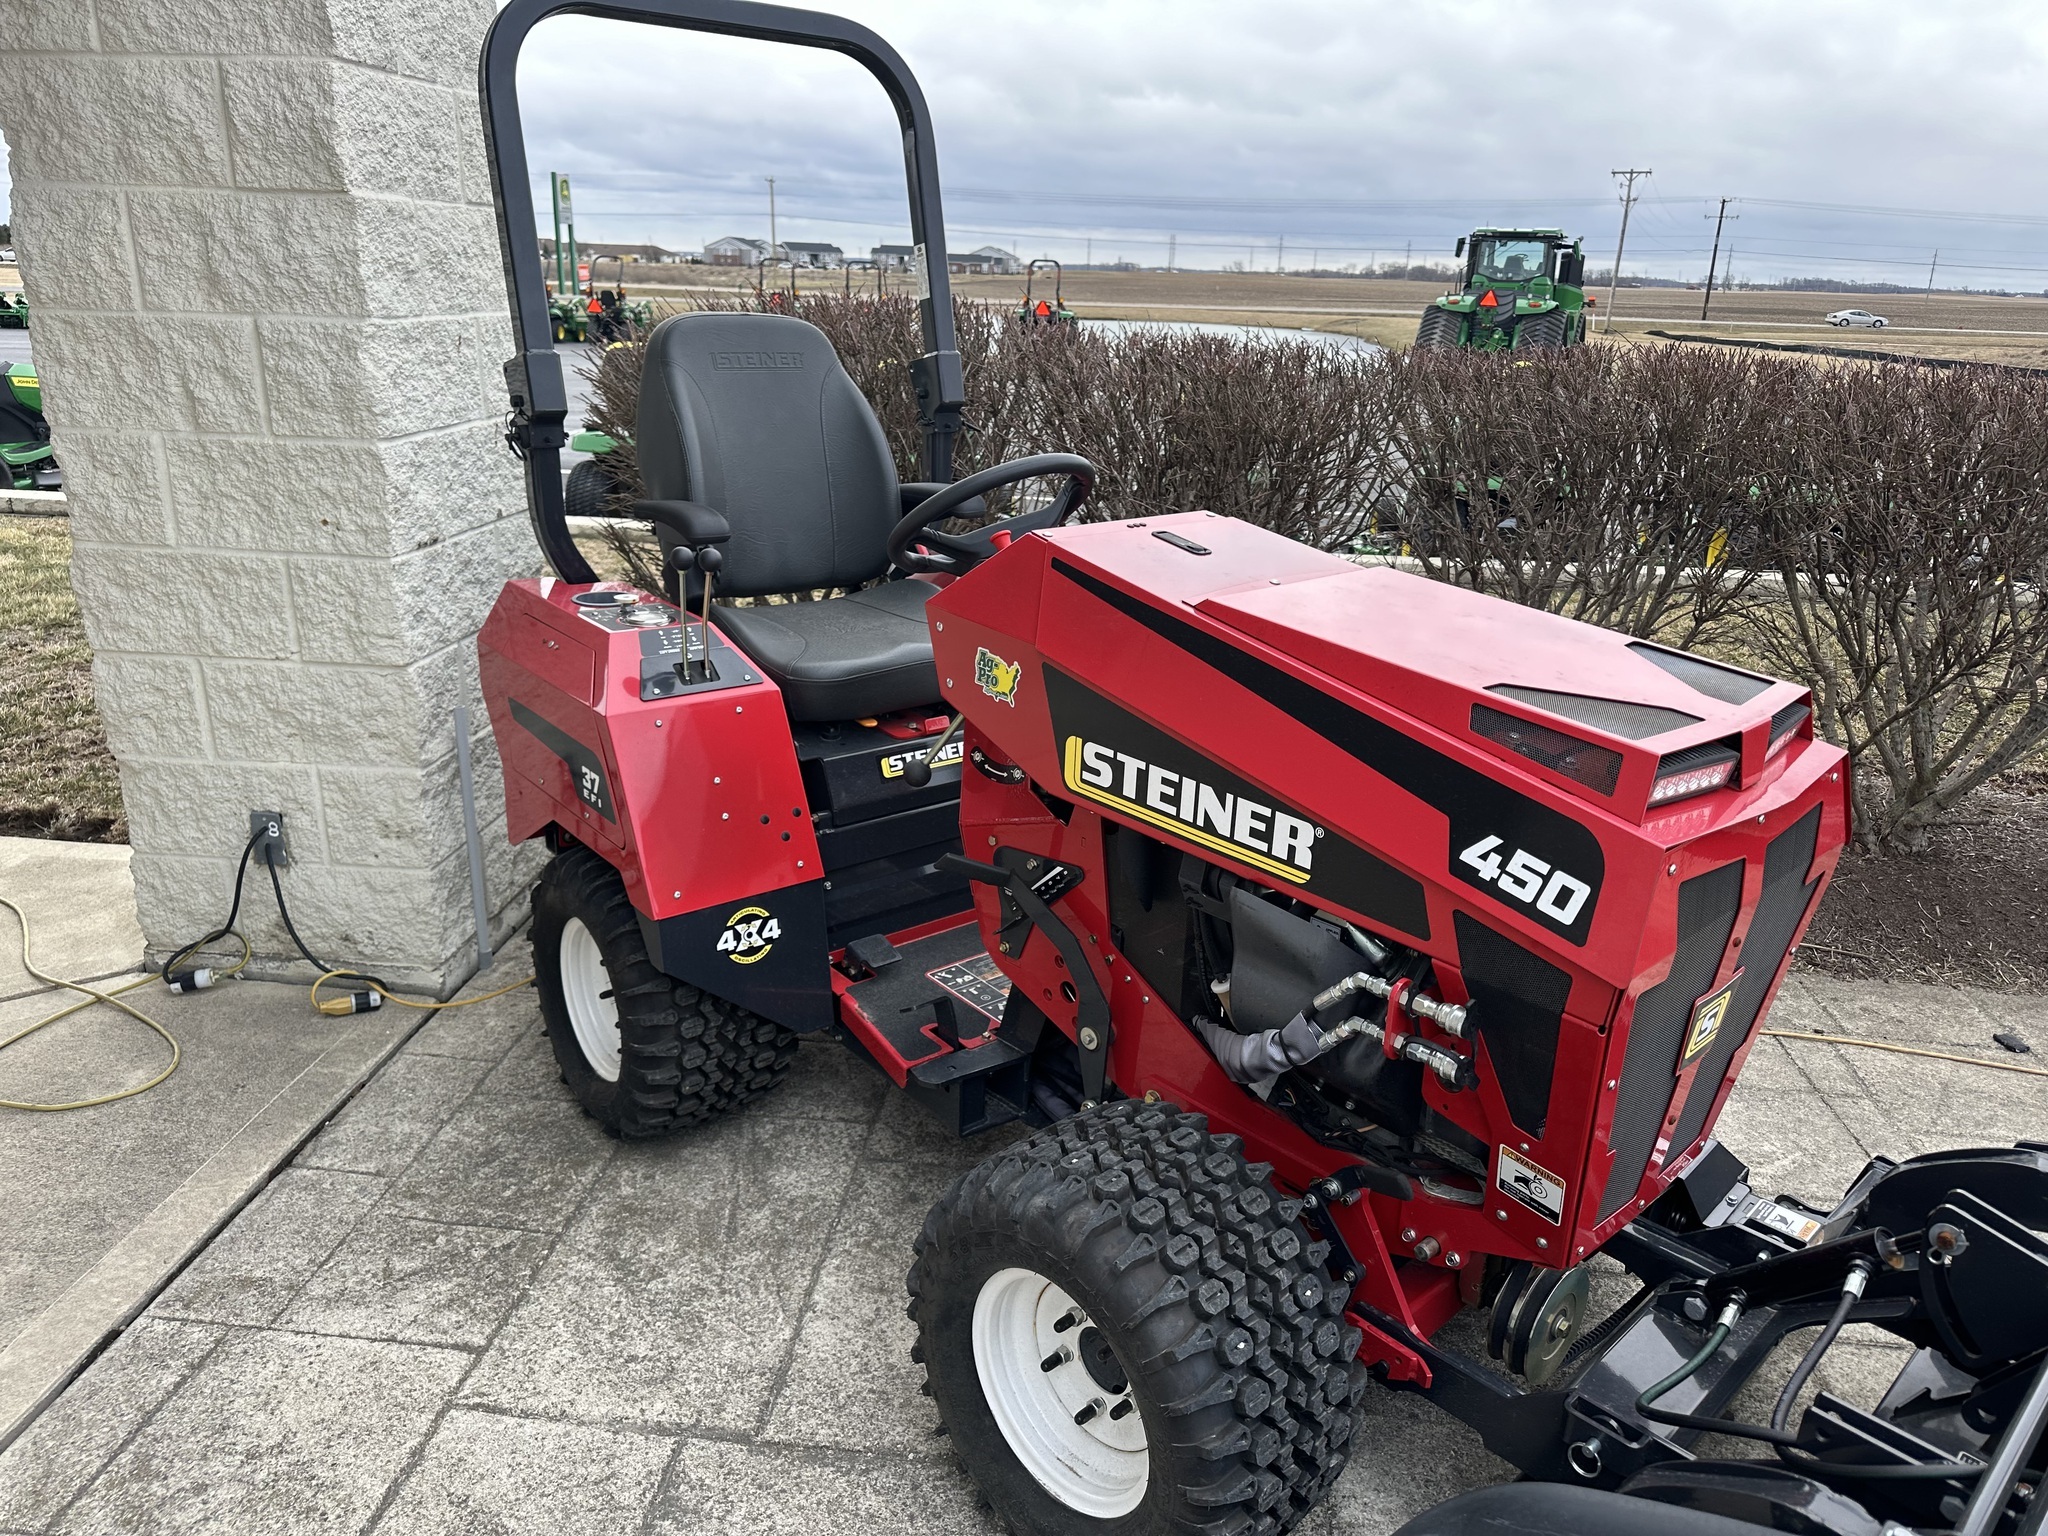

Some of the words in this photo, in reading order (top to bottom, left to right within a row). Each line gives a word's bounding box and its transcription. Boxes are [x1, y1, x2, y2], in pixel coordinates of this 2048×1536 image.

[715, 351, 804, 368] STEINER
[977, 666, 998, 687] Pro
[581, 765, 600, 794] 37
[268, 821, 280, 837] 8
[1458, 834, 1592, 926] 450
[729, 907, 767, 925] ARTICULATING
[733, 947, 769, 963] OSCILLATING
[1515, 1154, 1561, 1187] WARNING
